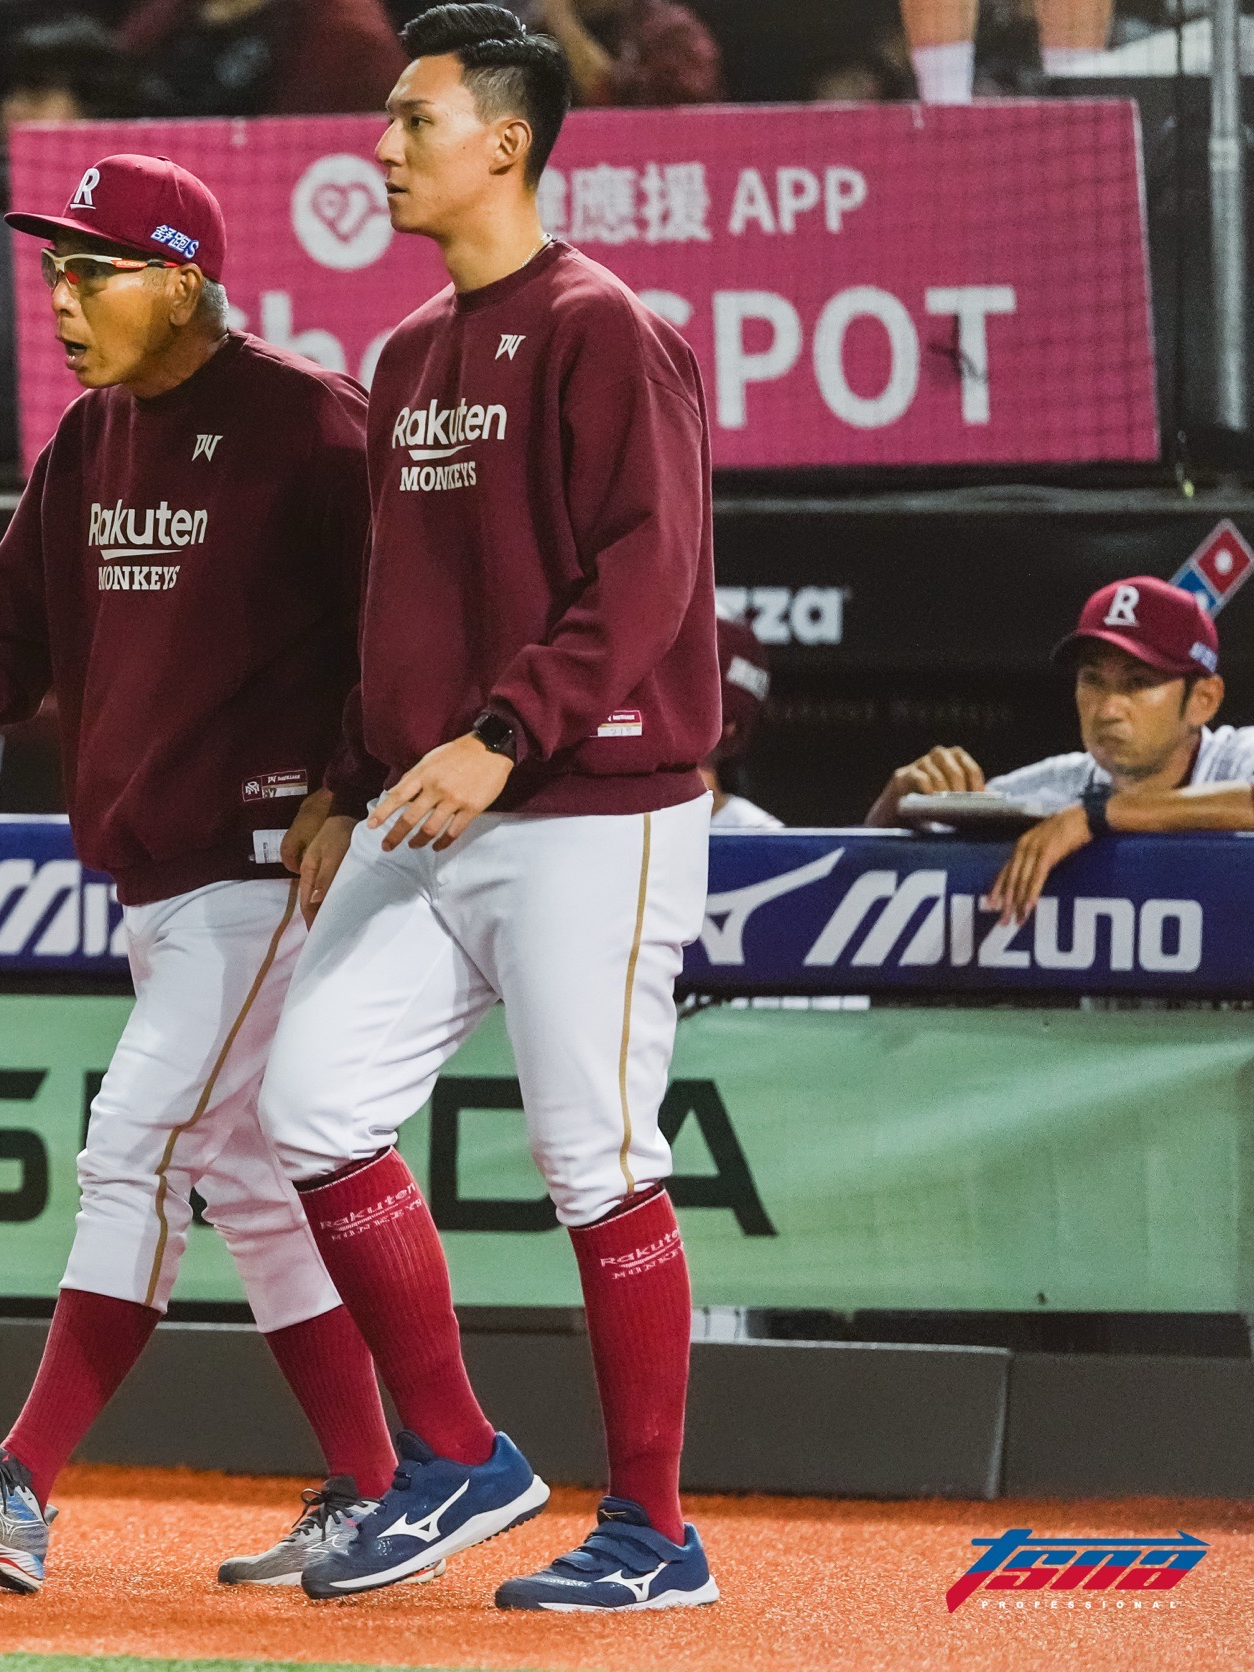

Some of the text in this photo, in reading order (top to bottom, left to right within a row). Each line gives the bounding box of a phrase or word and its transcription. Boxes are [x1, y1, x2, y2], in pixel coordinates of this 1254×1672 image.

[70, 167, 100, 210] R
[728, 166, 868, 235] APP
[639, 284, 1017, 431] POT
[392, 398, 507, 449] Rakuten
[399, 461, 477, 492] MONKEYS
[88, 498, 208, 547] Rakuten
[98, 565, 180, 591] MONKEYS
[1104, 585, 1140, 627] R
